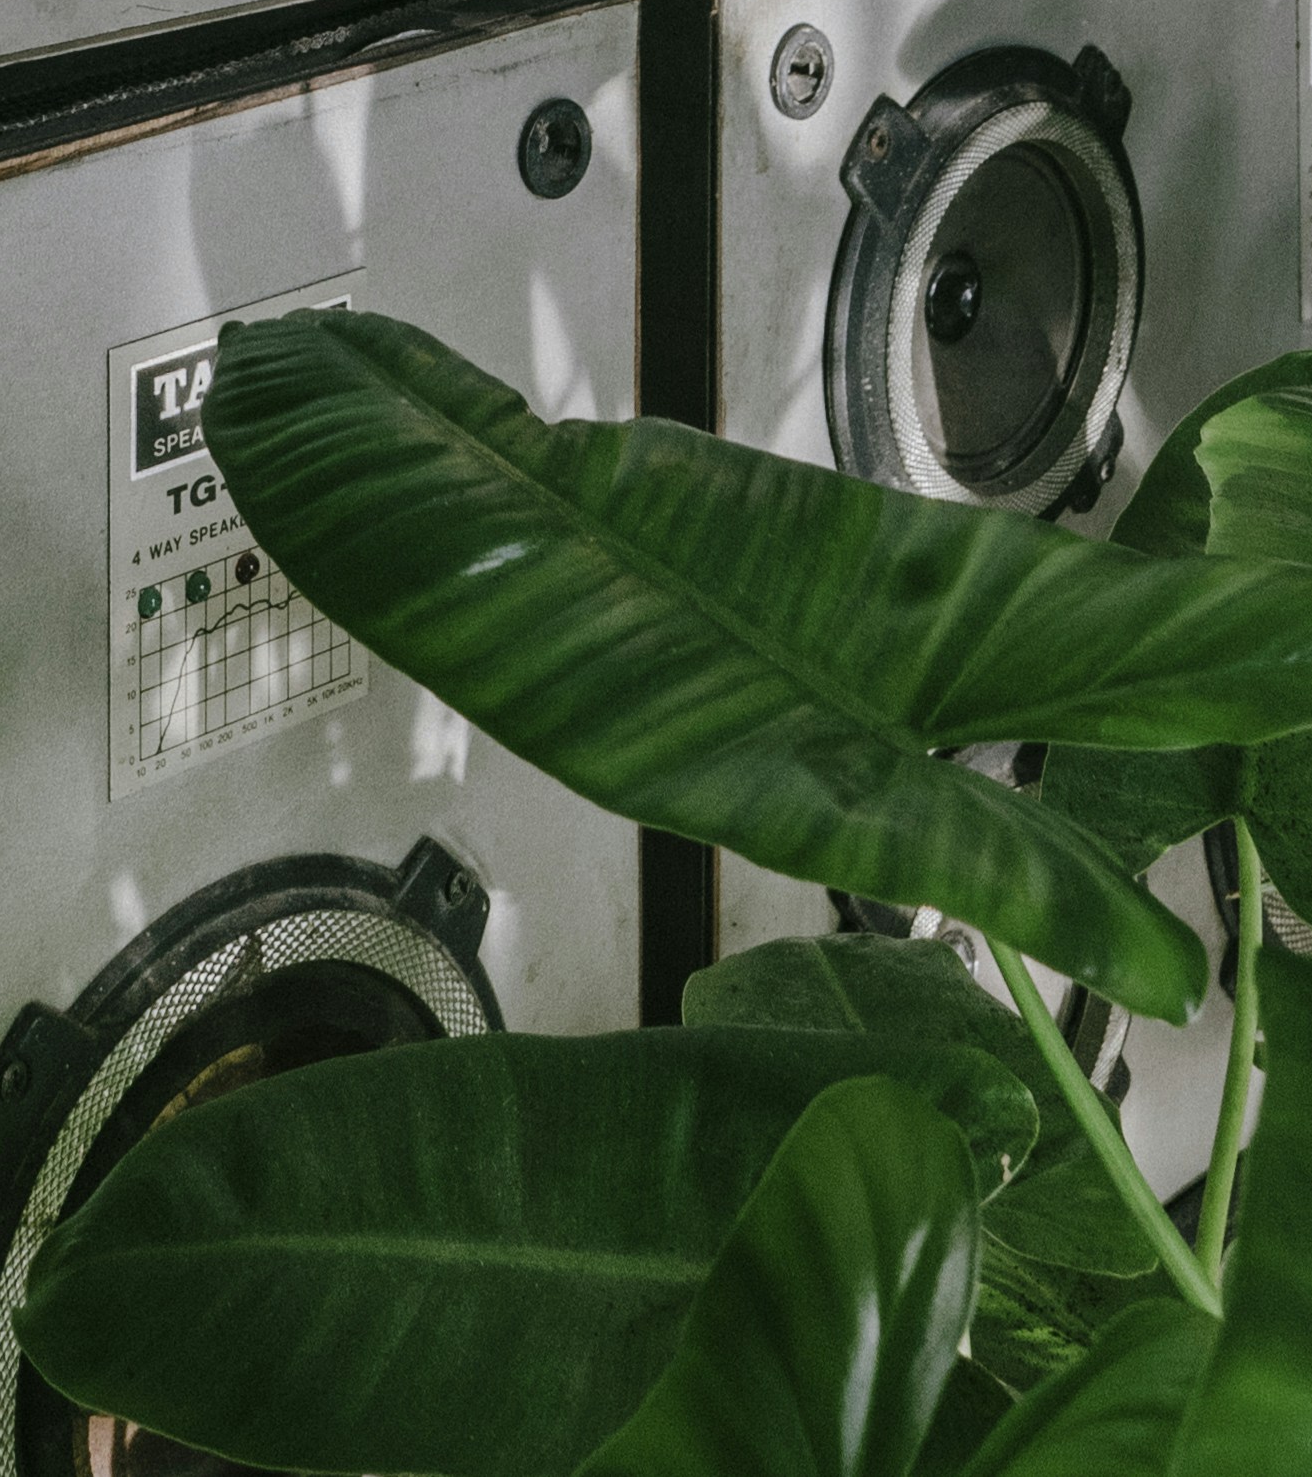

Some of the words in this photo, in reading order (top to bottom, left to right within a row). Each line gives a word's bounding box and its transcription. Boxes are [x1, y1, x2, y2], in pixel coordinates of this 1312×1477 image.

[153, 425, 204, 457] SPEA
[132, 550, 141, 566] 4
[149, 535, 183, 560] WAY
[125, 590, 137, 602] 25
[125, 623, 137, 635] 20
[127, 657, 136, 667] 15
[127, 691, 137, 701] 10
[155, 758, 167, 770] 20
[199, 738, 214, 751] 100
[217, 730, 233, 744] 200
[242, 720, 258, 734] 500
[282, 705, 294, 718] 2K
[306, 696, 319, 708] 5K
[321, 687, 336, 700] 10K
